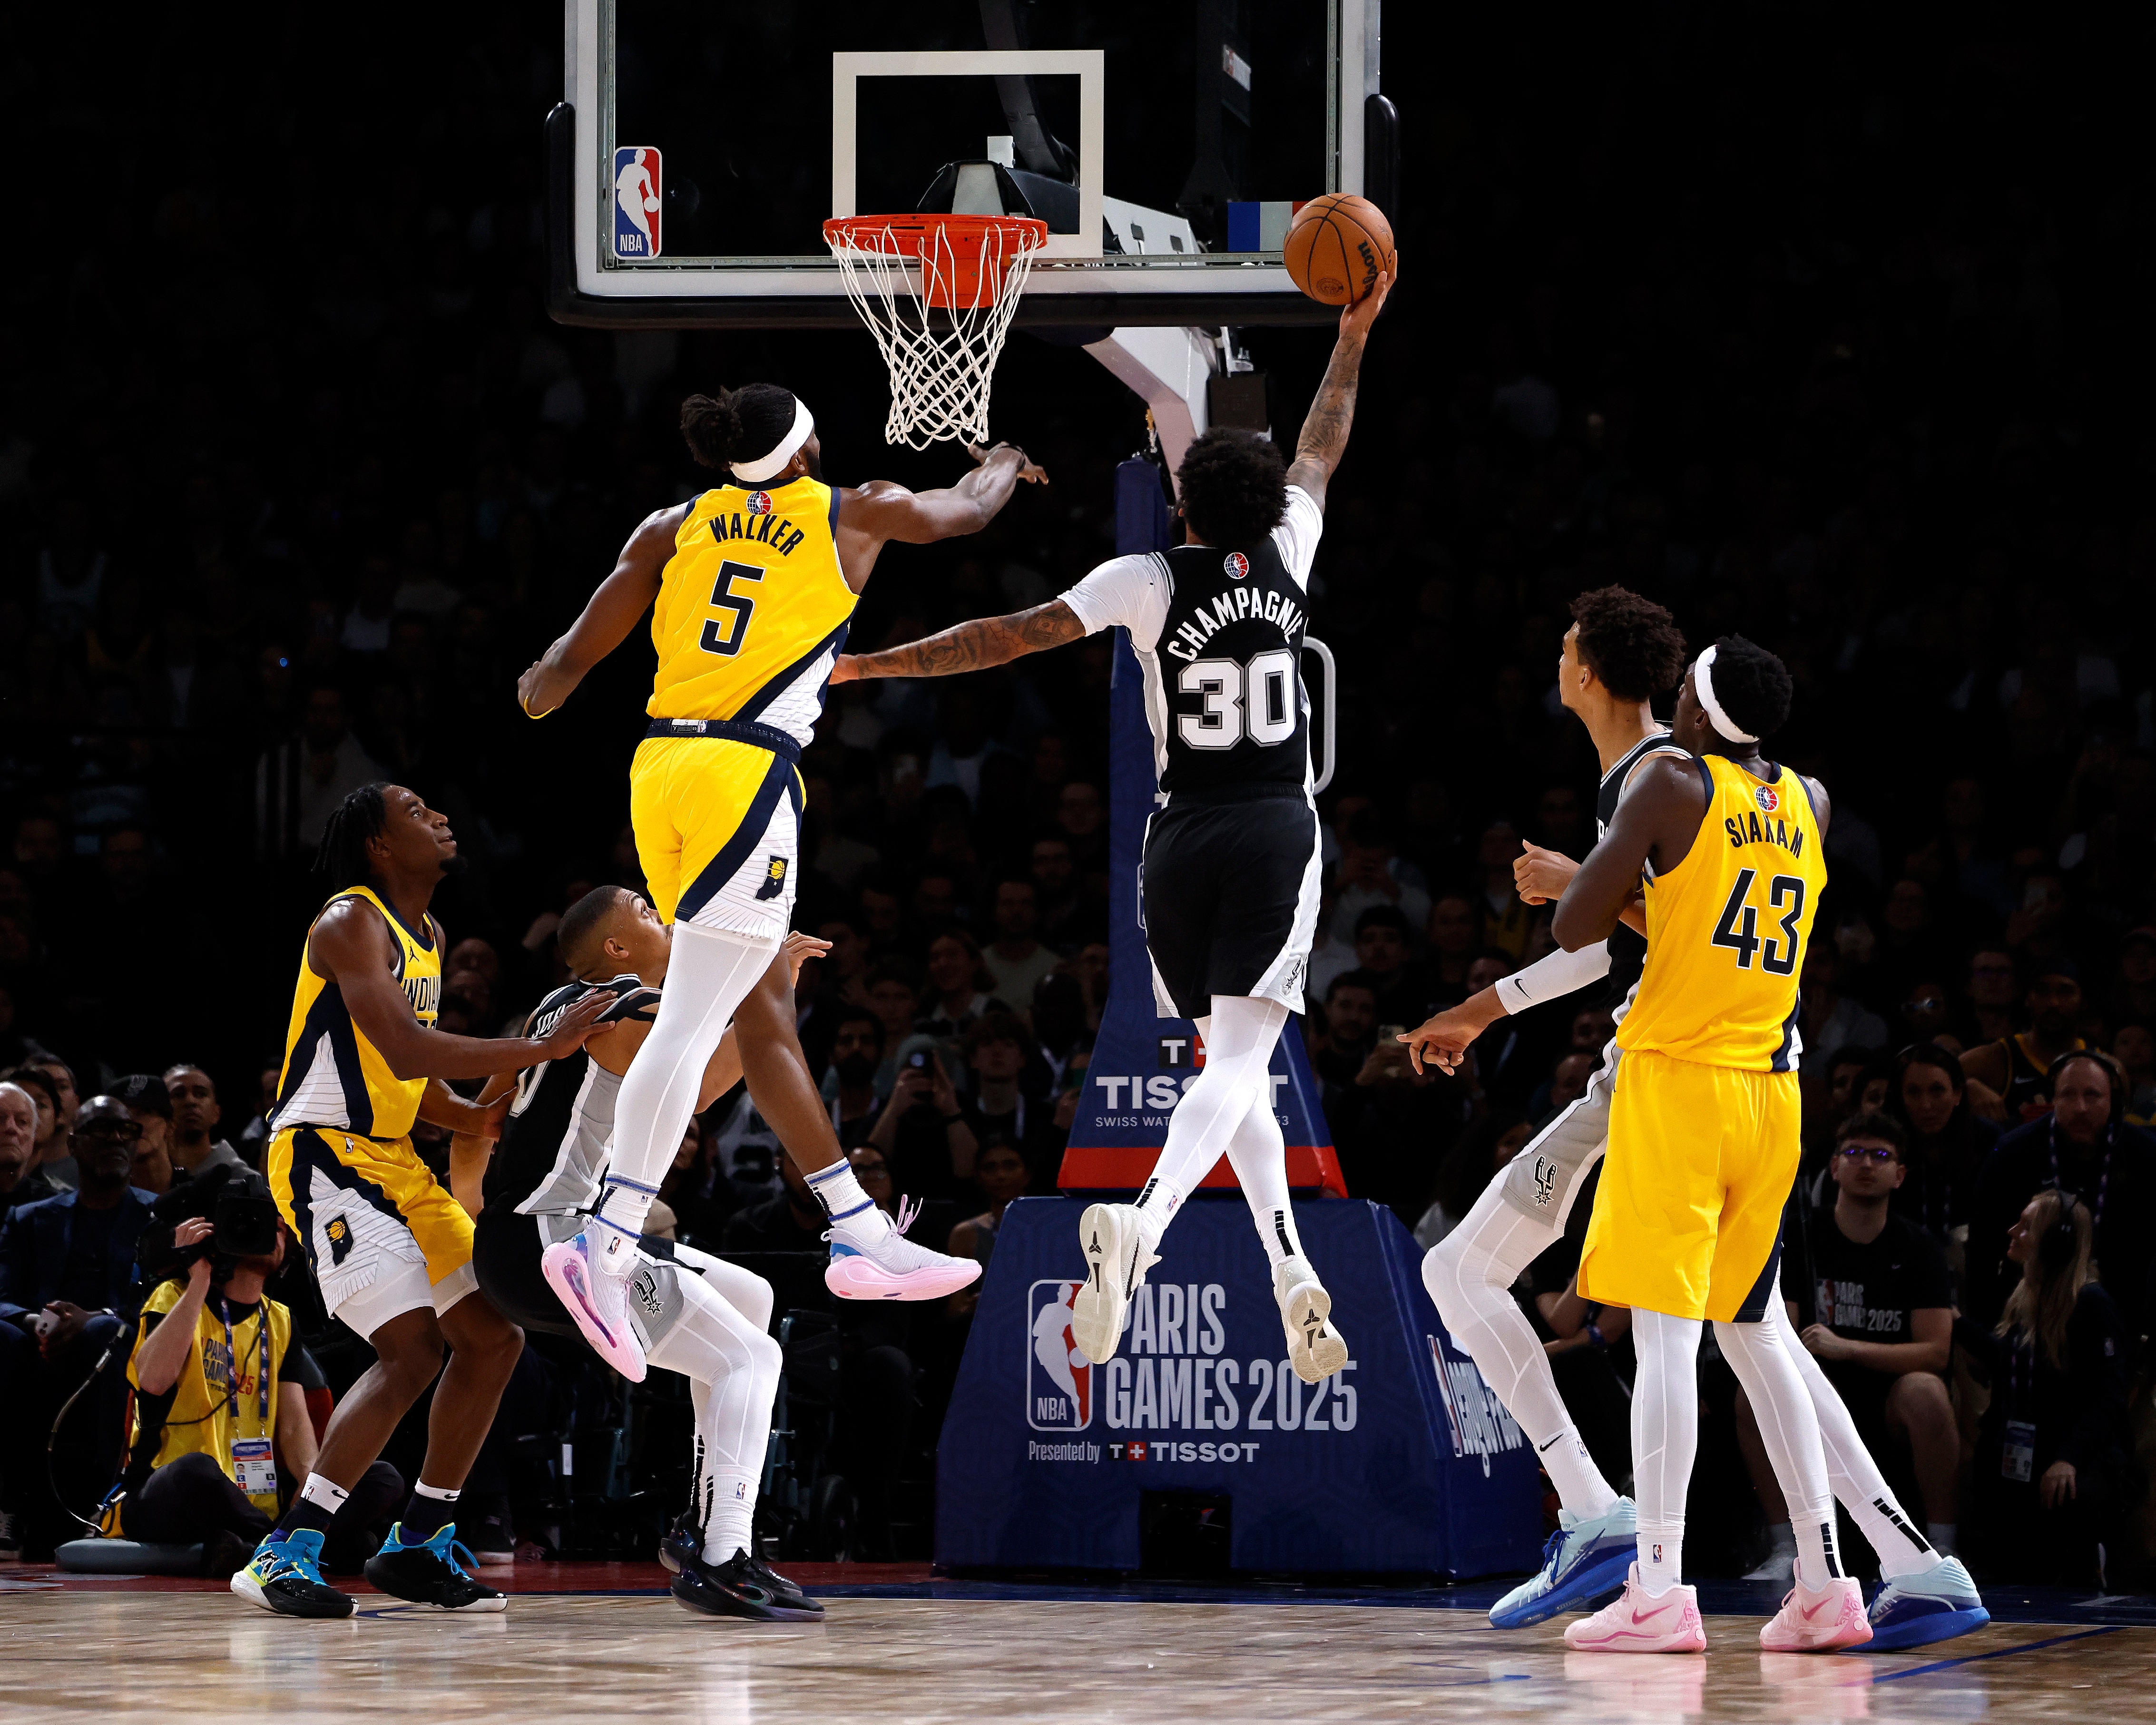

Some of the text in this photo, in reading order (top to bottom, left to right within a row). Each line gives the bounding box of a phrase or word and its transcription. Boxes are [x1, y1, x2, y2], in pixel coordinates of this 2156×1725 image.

[620, 234, 643, 252] NBA
[709, 513, 804, 557] WALKER
[698, 559, 766, 657] 5
[1177, 648, 1296, 750] 30
[1711, 867, 1806, 977] 43
[1096, 1075, 1289, 1109] TIST
[1096, 1117, 1137, 1127] SWISS
[1122, 1284, 1226, 1355] ARIS
[1867, 1309, 1902, 1332] 2025
[1038, 1398, 1068, 1421] NBA
[1106, 1358, 1358, 1431] GAMES 2025
[1029, 1440, 1085, 1460] Presented
[1088, 1441, 1100, 1464] by
[1150, 1442, 1260, 1462] TISSOT
